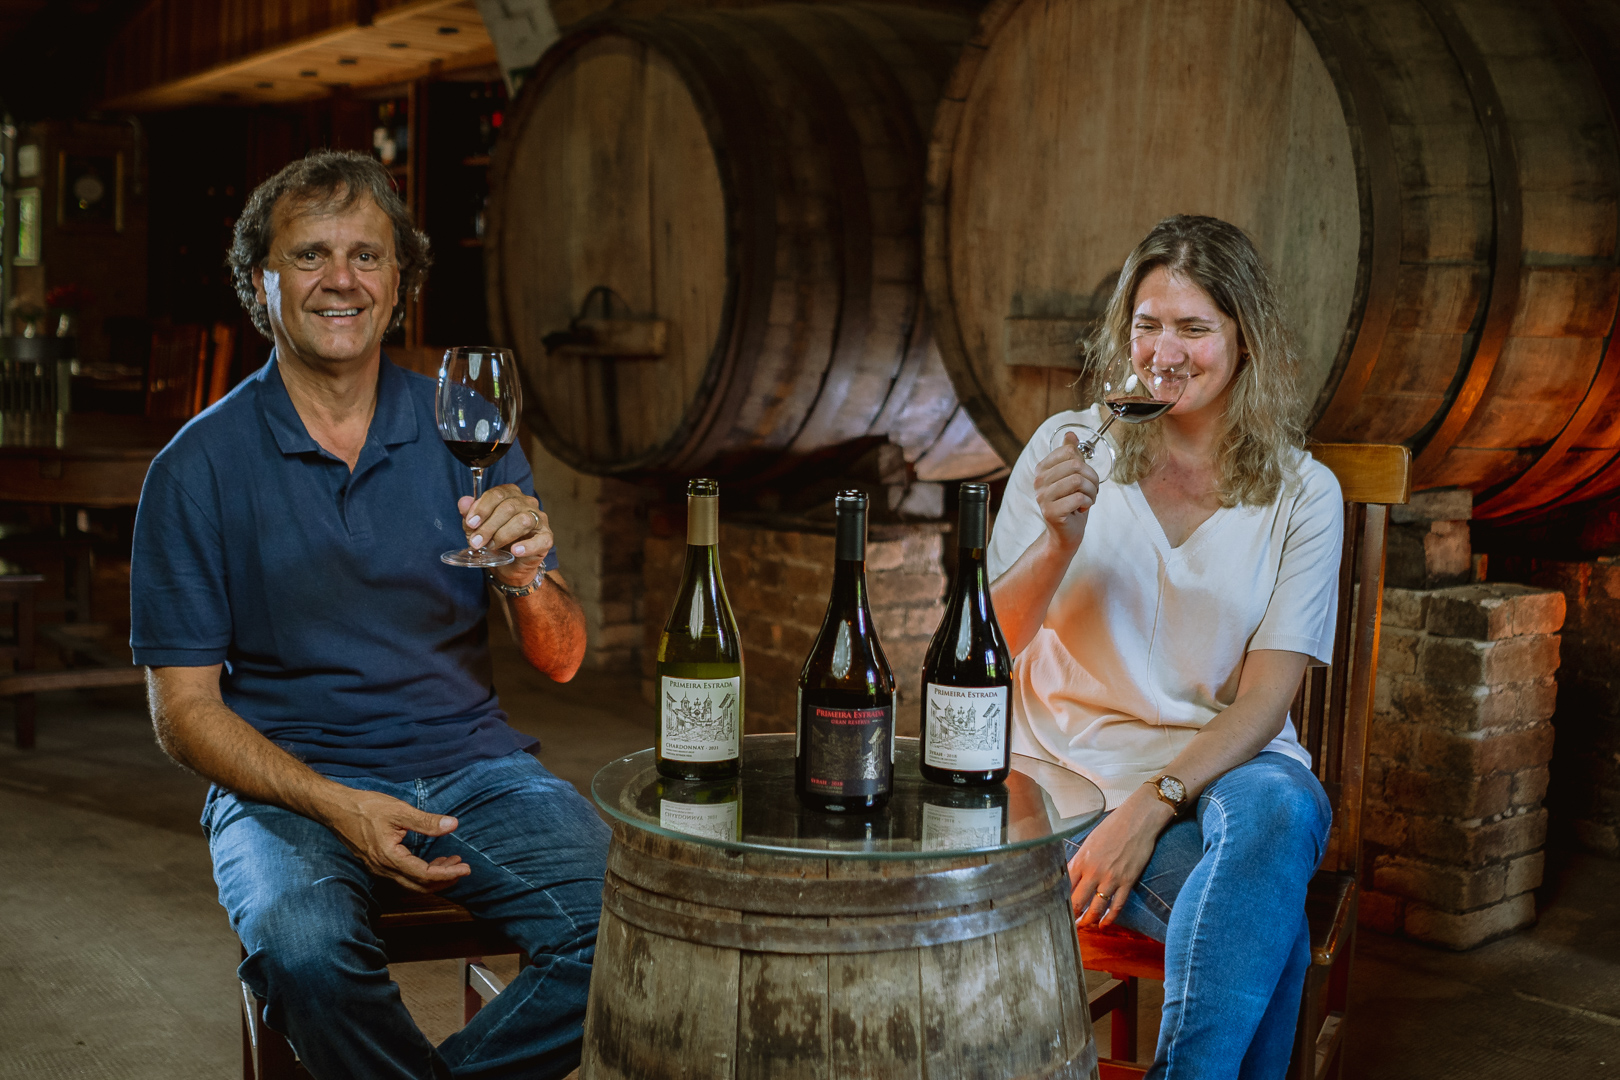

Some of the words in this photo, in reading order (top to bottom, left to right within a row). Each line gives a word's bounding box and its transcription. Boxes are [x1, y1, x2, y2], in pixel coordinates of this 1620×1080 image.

[669, 680, 701, 689] PRIMEIRA
[703, 681, 732, 689] ESTRADA
[934, 687, 966, 698] PRIMEIRA
[816, 708, 852, 719] PRIMEIRA
[853, 709, 884, 719] ESTRADA
[665, 742, 705, 750] CHARDONNAY
